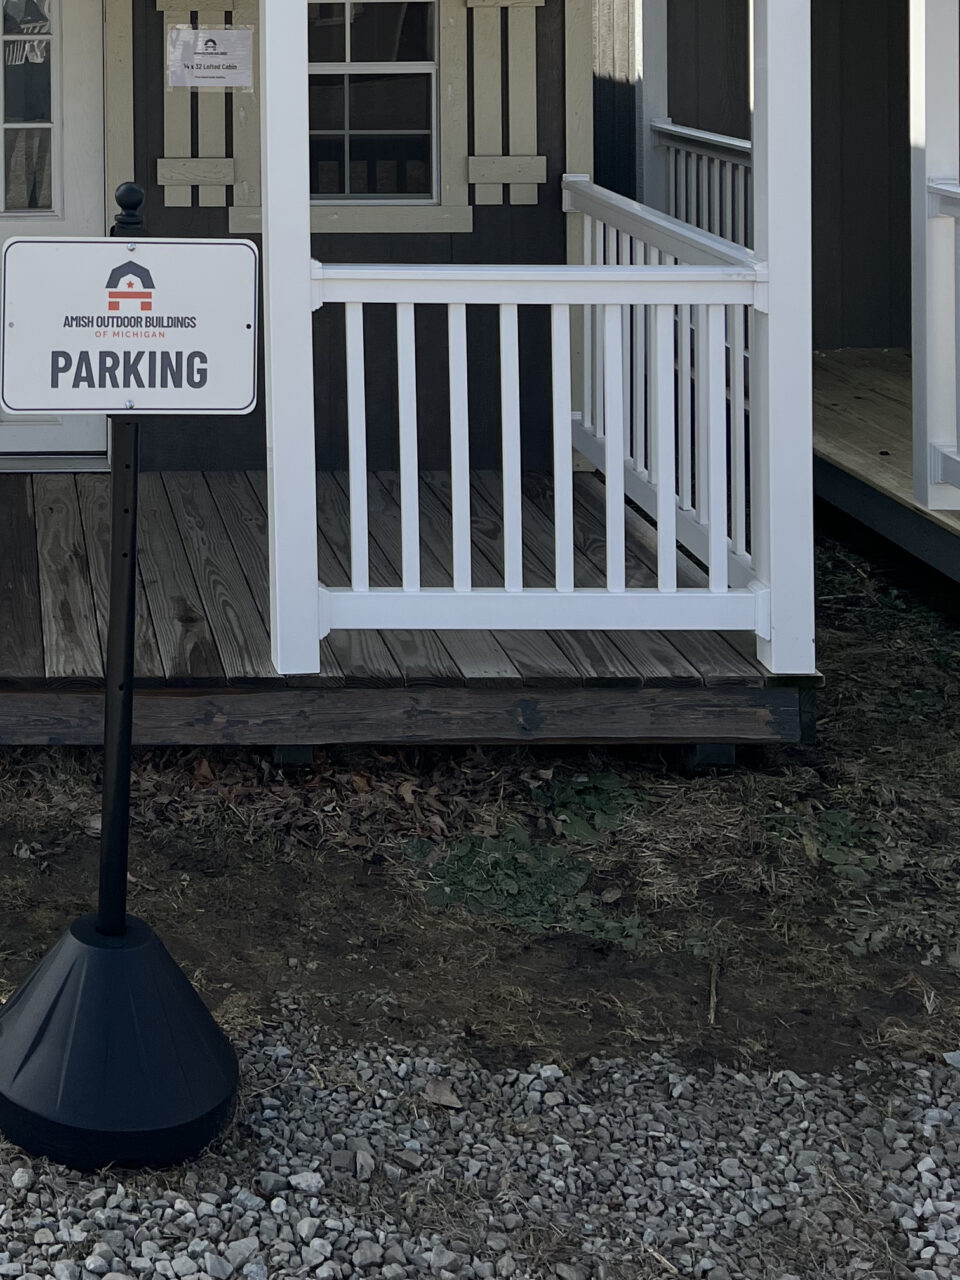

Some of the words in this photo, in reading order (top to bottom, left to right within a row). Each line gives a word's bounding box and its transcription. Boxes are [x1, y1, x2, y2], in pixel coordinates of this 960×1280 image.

[63, 315, 94, 328] AMISH
[96, 315, 143, 328] OUTDOOR
[144, 316, 197, 329] BUILDINGS
[95, 330, 108, 338] OF
[112, 330, 166, 339] MICHIGAN
[50, 350, 208, 389] PARKING
